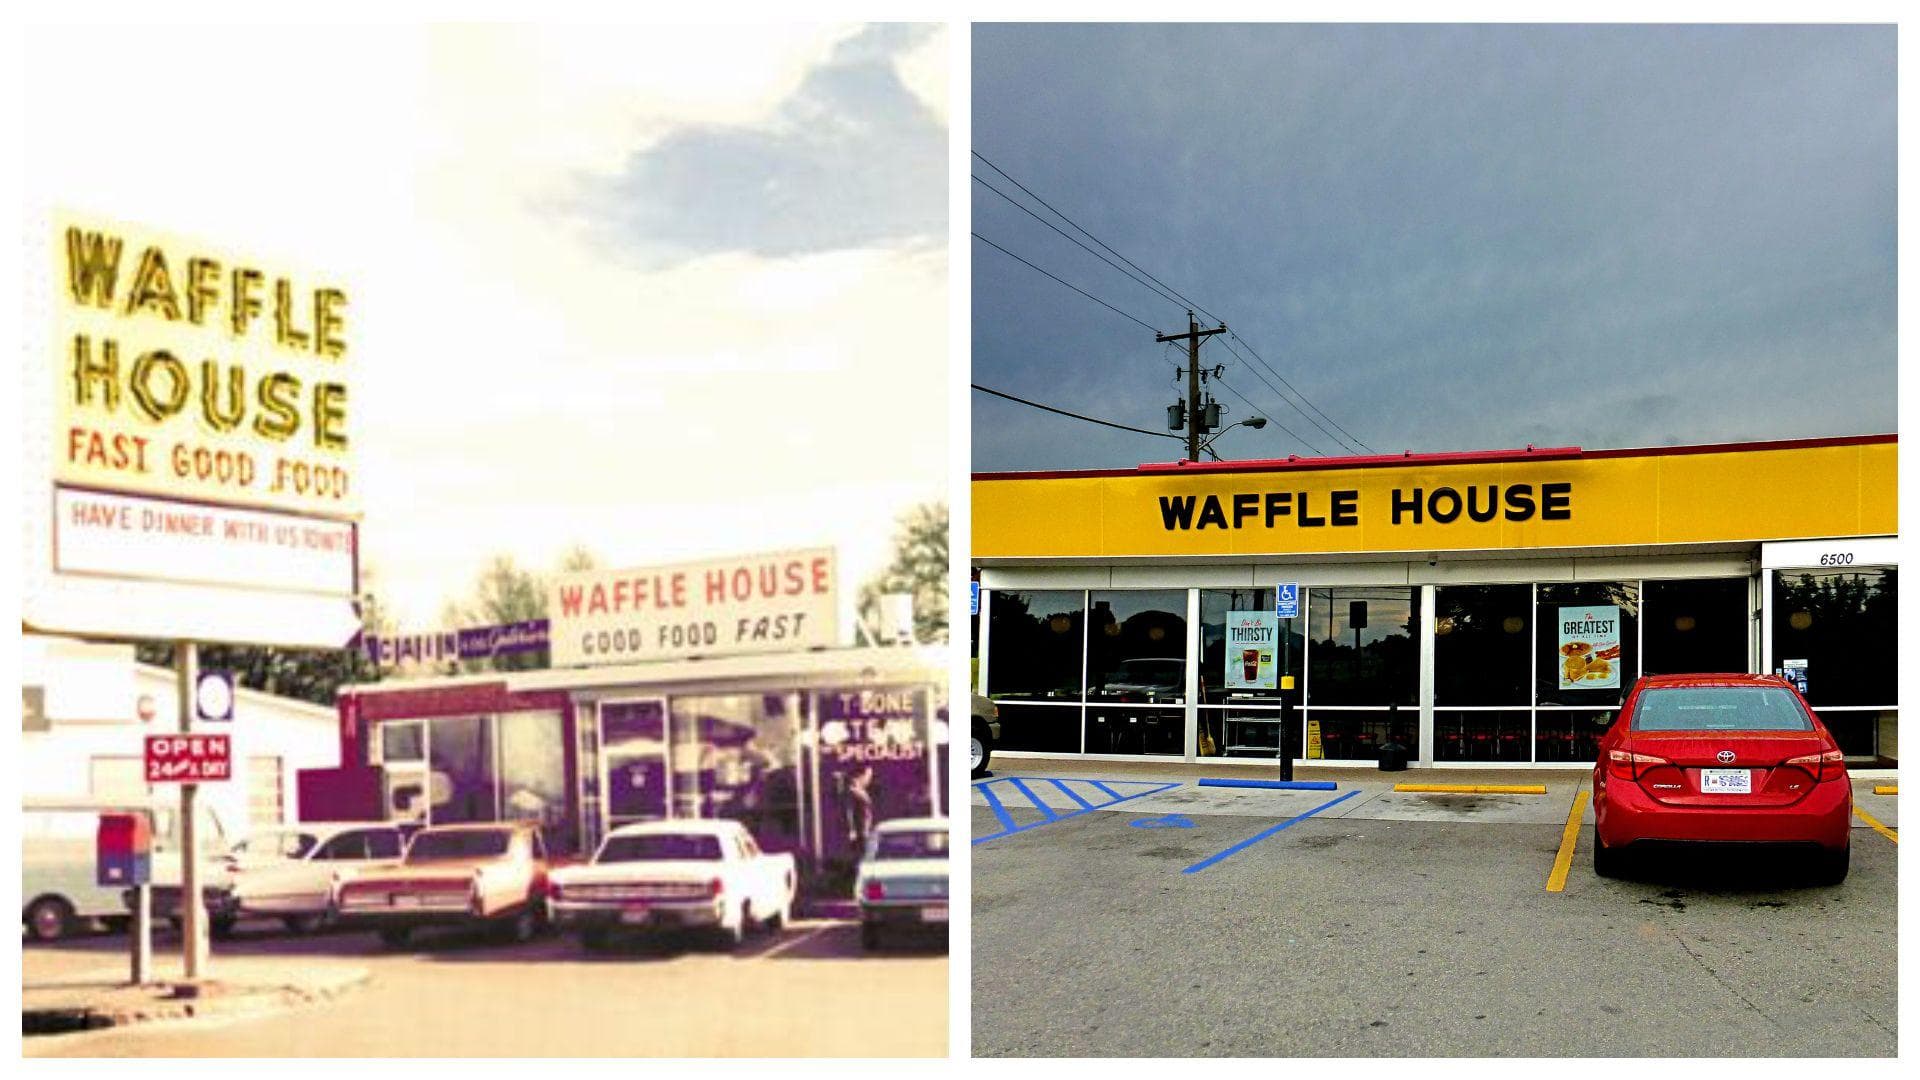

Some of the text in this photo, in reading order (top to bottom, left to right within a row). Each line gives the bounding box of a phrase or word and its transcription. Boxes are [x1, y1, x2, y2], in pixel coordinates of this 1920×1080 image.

[66, 226, 348, 358] WAFFLE
[74, 334, 349, 448] HOUSE
[68, 426, 349, 500] FAST GOOD FOOD
[71, 501, 132, 531] HAVE
[142, 508, 214, 536] DINNER
[224, 519, 269, 544] WITH
[275, 525, 298, 549] US
[1158, 482, 1572, 531] WAFFLE HOUSE
[1820, 552, 1854, 566] 6500
[560, 557, 830, 618] WAFFLE HOUSE
[581, 628, 642, 655] GOOD
[658, 621, 718, 648] FOOD
[734, 612, 806, 642] FAST
[1230, 627, 1273, 641] THIRSTY
[1563, 620, 1614, 635] GREATEST
[840, 690, 914, 714] T-BONE
[152, 739, 227, 757] OPEN
